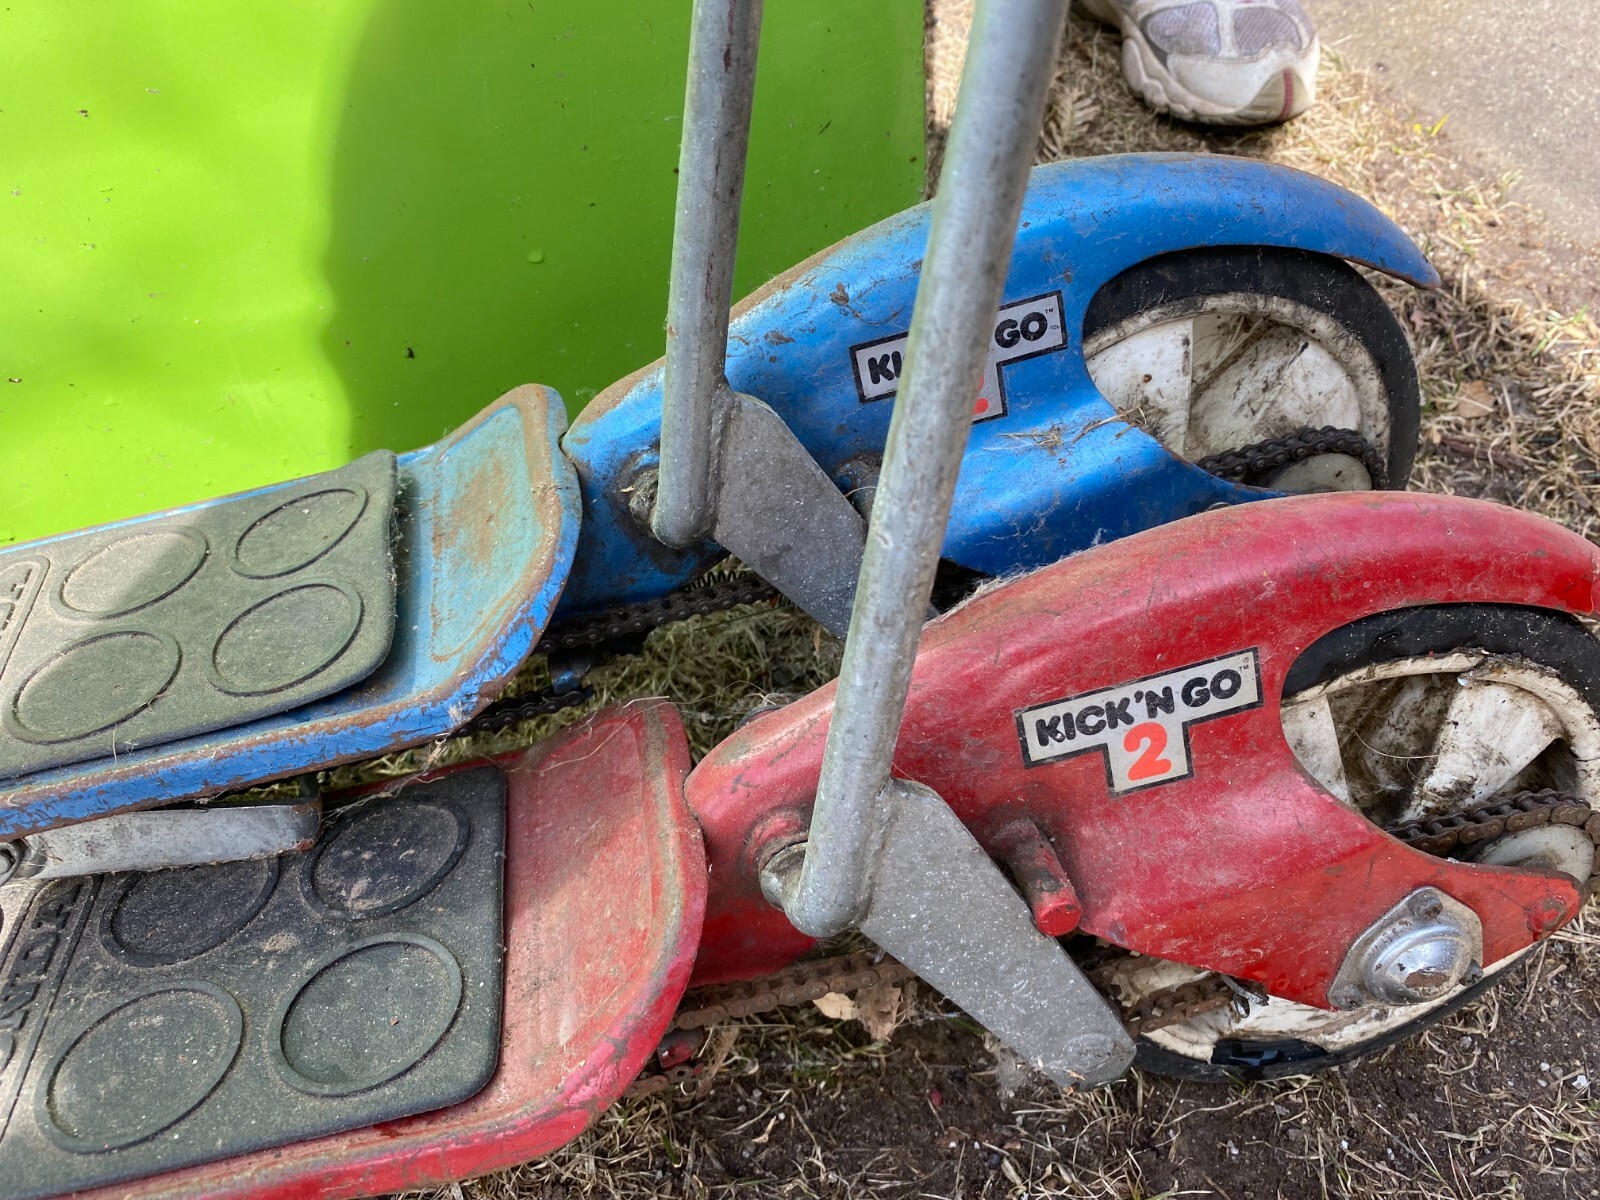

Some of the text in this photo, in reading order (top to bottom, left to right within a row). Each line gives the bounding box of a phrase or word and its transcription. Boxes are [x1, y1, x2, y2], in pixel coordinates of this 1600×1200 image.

[994, 311, 1048, 349] GO
[1035, 685, 1176, 747] KICK'N
[1180, 669, 1242, 708] GO
[1123, 721, 1172, 781] 2
